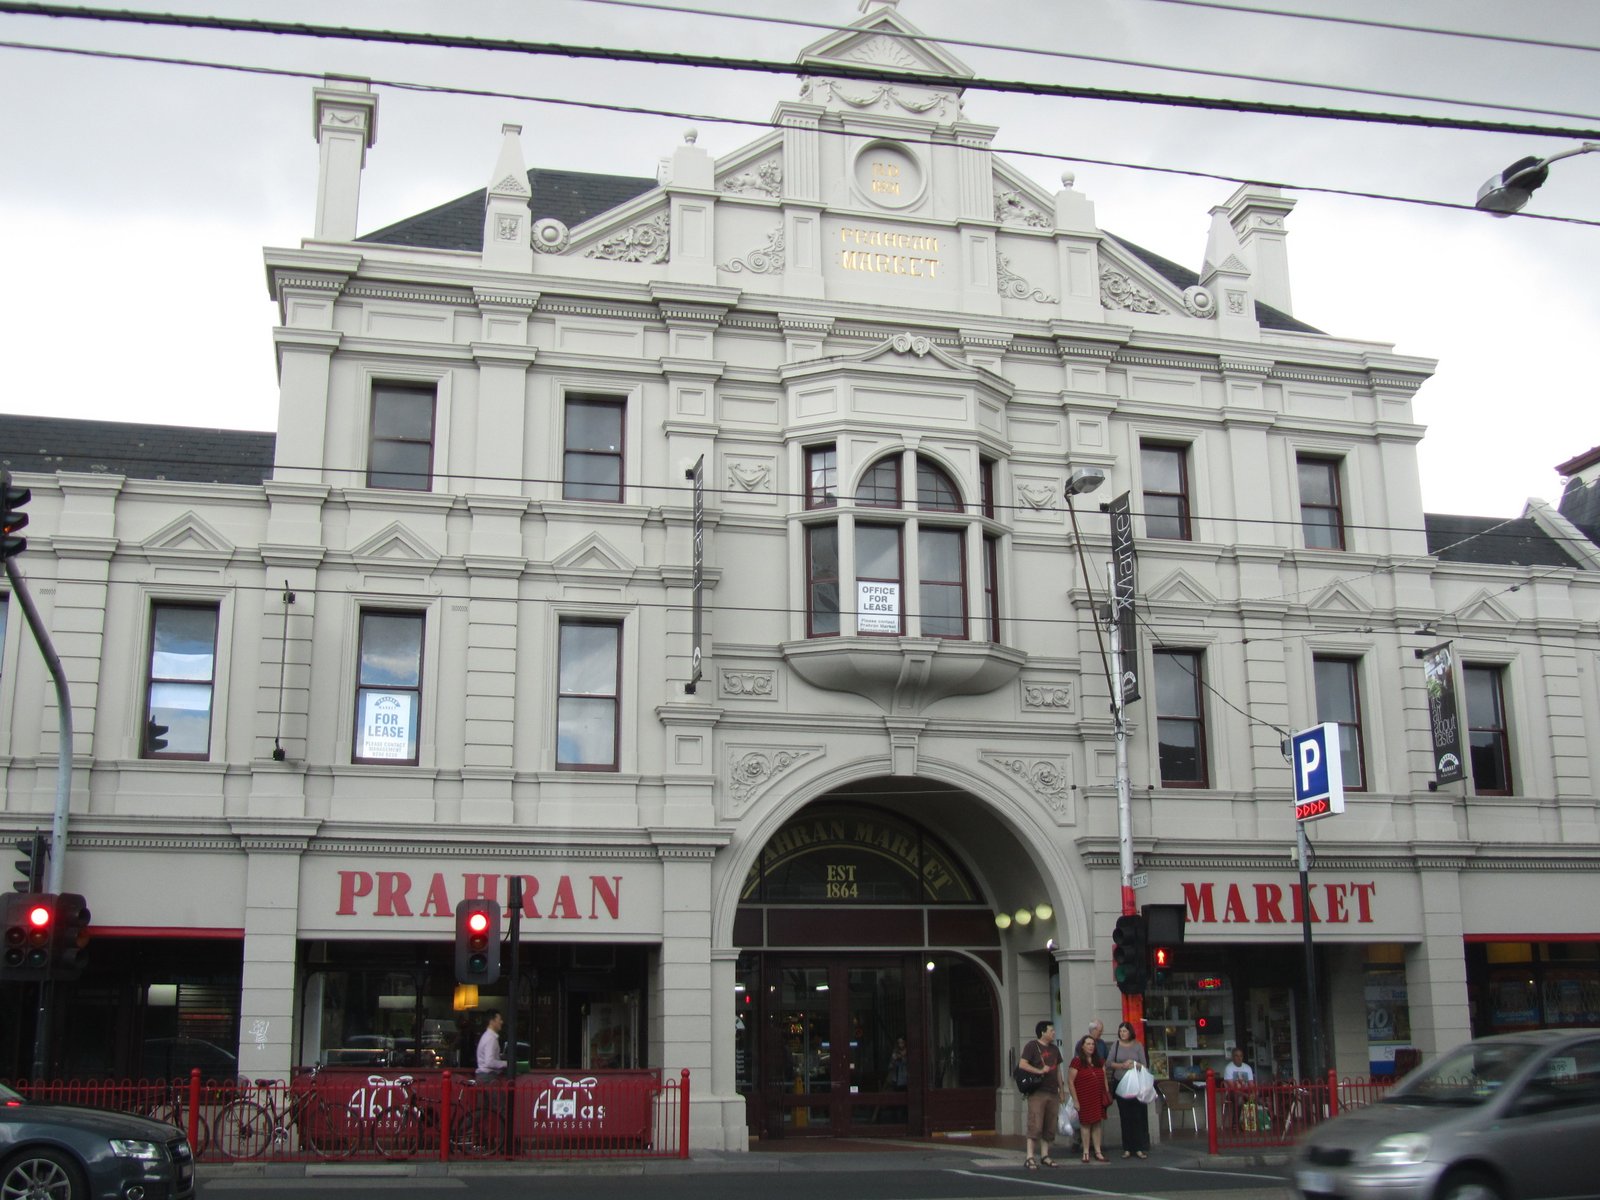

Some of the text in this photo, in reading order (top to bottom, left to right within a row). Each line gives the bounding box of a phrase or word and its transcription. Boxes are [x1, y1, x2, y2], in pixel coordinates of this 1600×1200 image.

[841, 227, 939, 252] PRAHRAN
[842, 250, 939, 278] MARKET
[1113, 500, 1134, 610] Market
[862, 586, 895, 595] OFFICE
[864, 603, 893, 611] LEASE
[869, 595, 888, 603] FOR
[375, 713, 399, 725] FOR
[368, 725, 404, 738] LEASE
[1300, 739, 1320, 792] P
[827, 865, 857, 881] EST
[336, 870, 622, 919] PRAHRAN
[826, 882, 858, 898] 1864
[1181, 881, 1376, 923] MARKET
